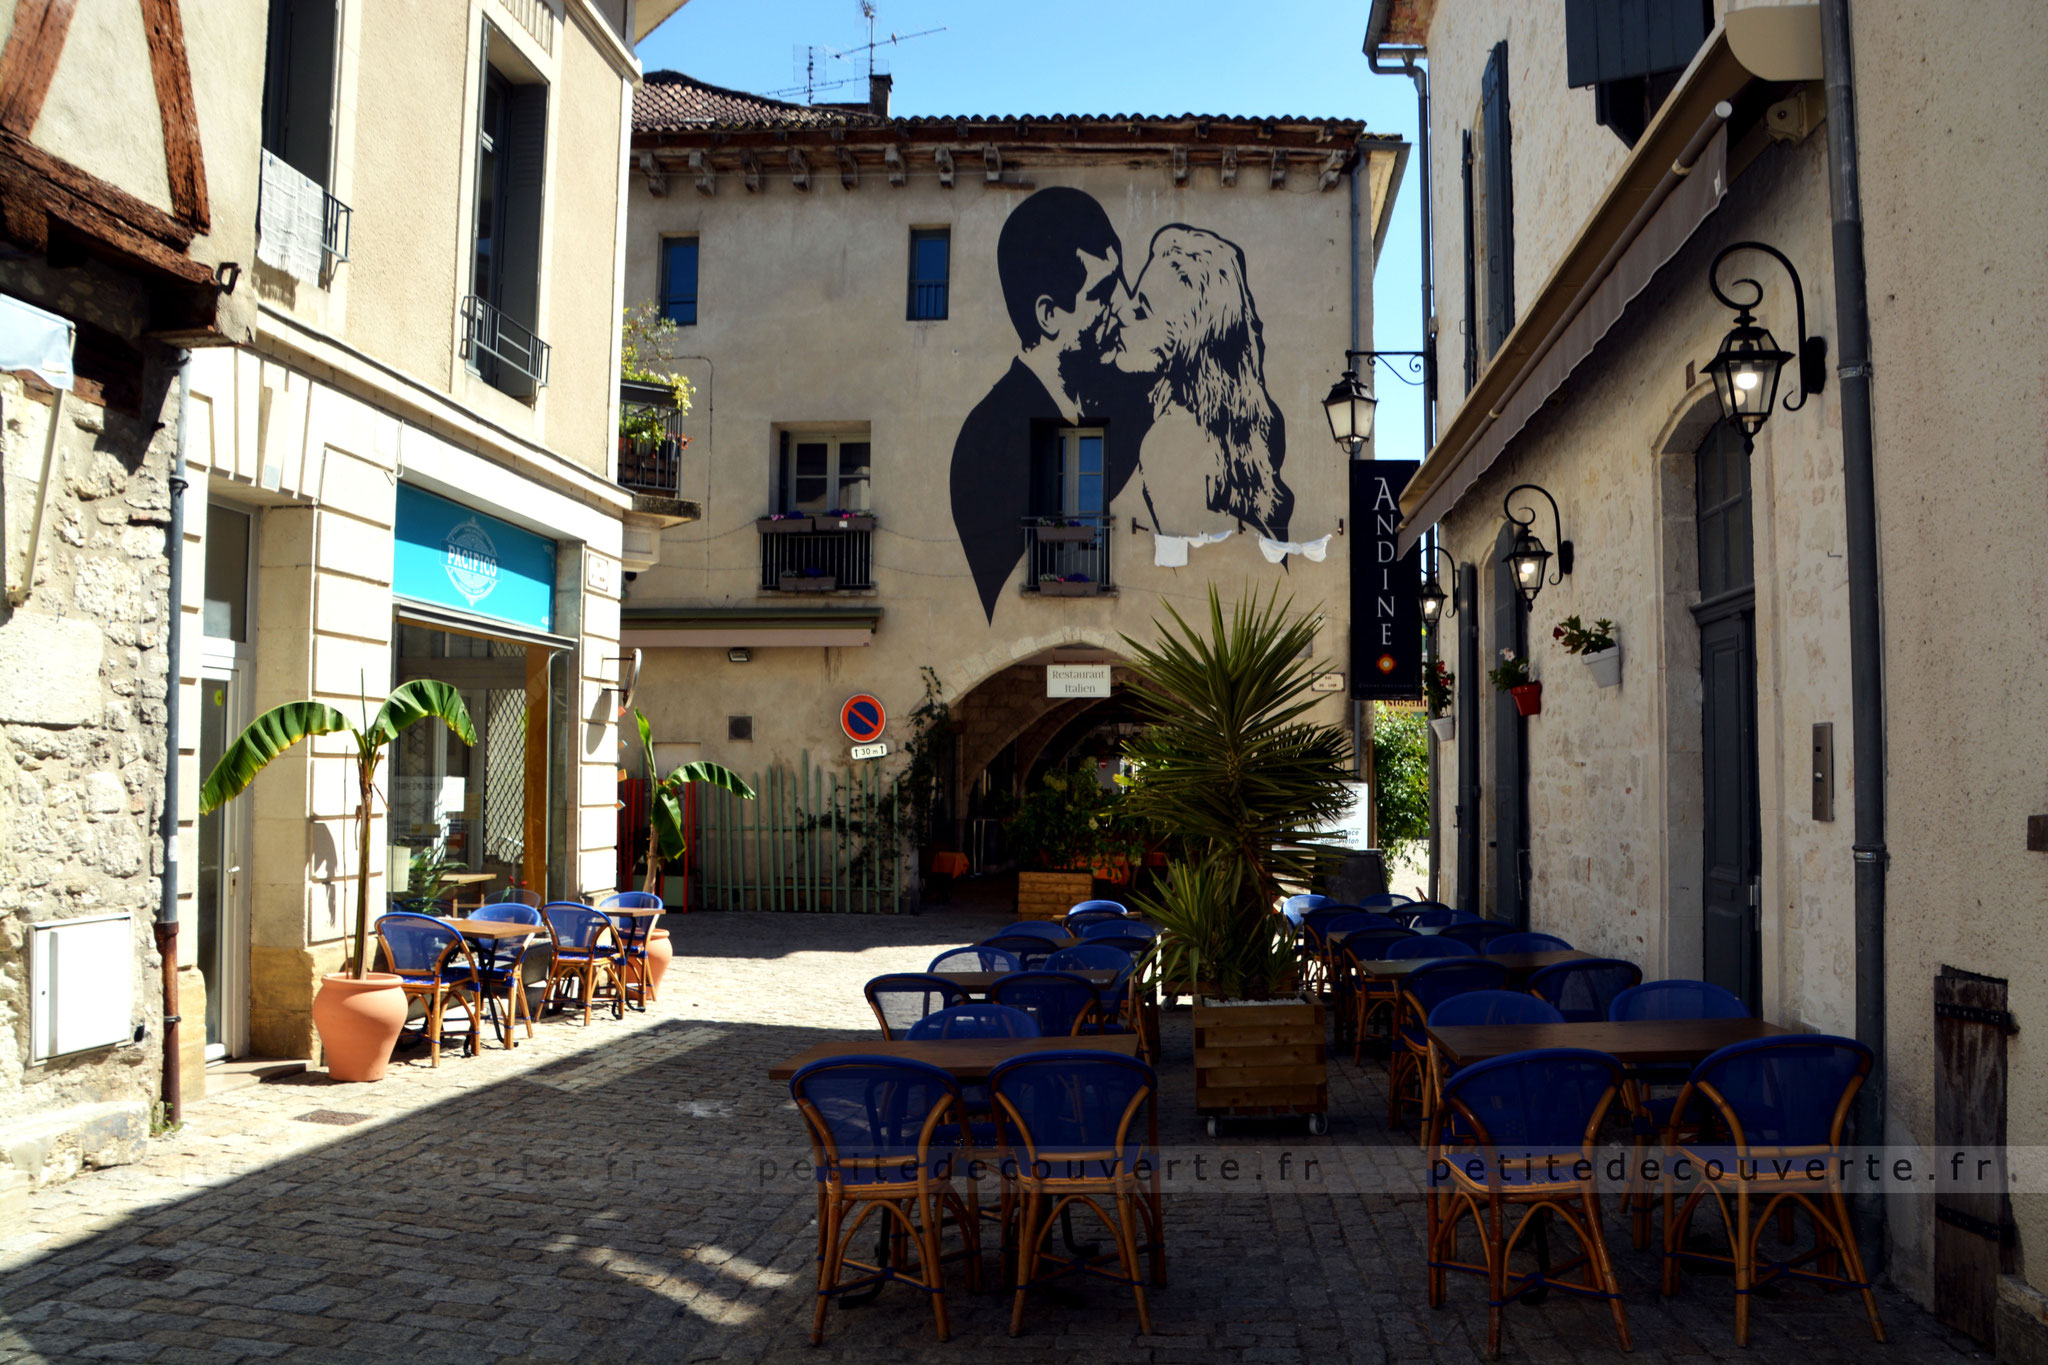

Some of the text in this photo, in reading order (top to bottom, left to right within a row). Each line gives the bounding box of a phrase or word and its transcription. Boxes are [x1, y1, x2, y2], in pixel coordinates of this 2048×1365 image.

[447, 544, 498, 578] PACIFICO
[1372, 476, 1399, 646] ANDINE
[1052, 670, 1105, 679] Restaurant
[1064, 683, 1096, 693] Italien
